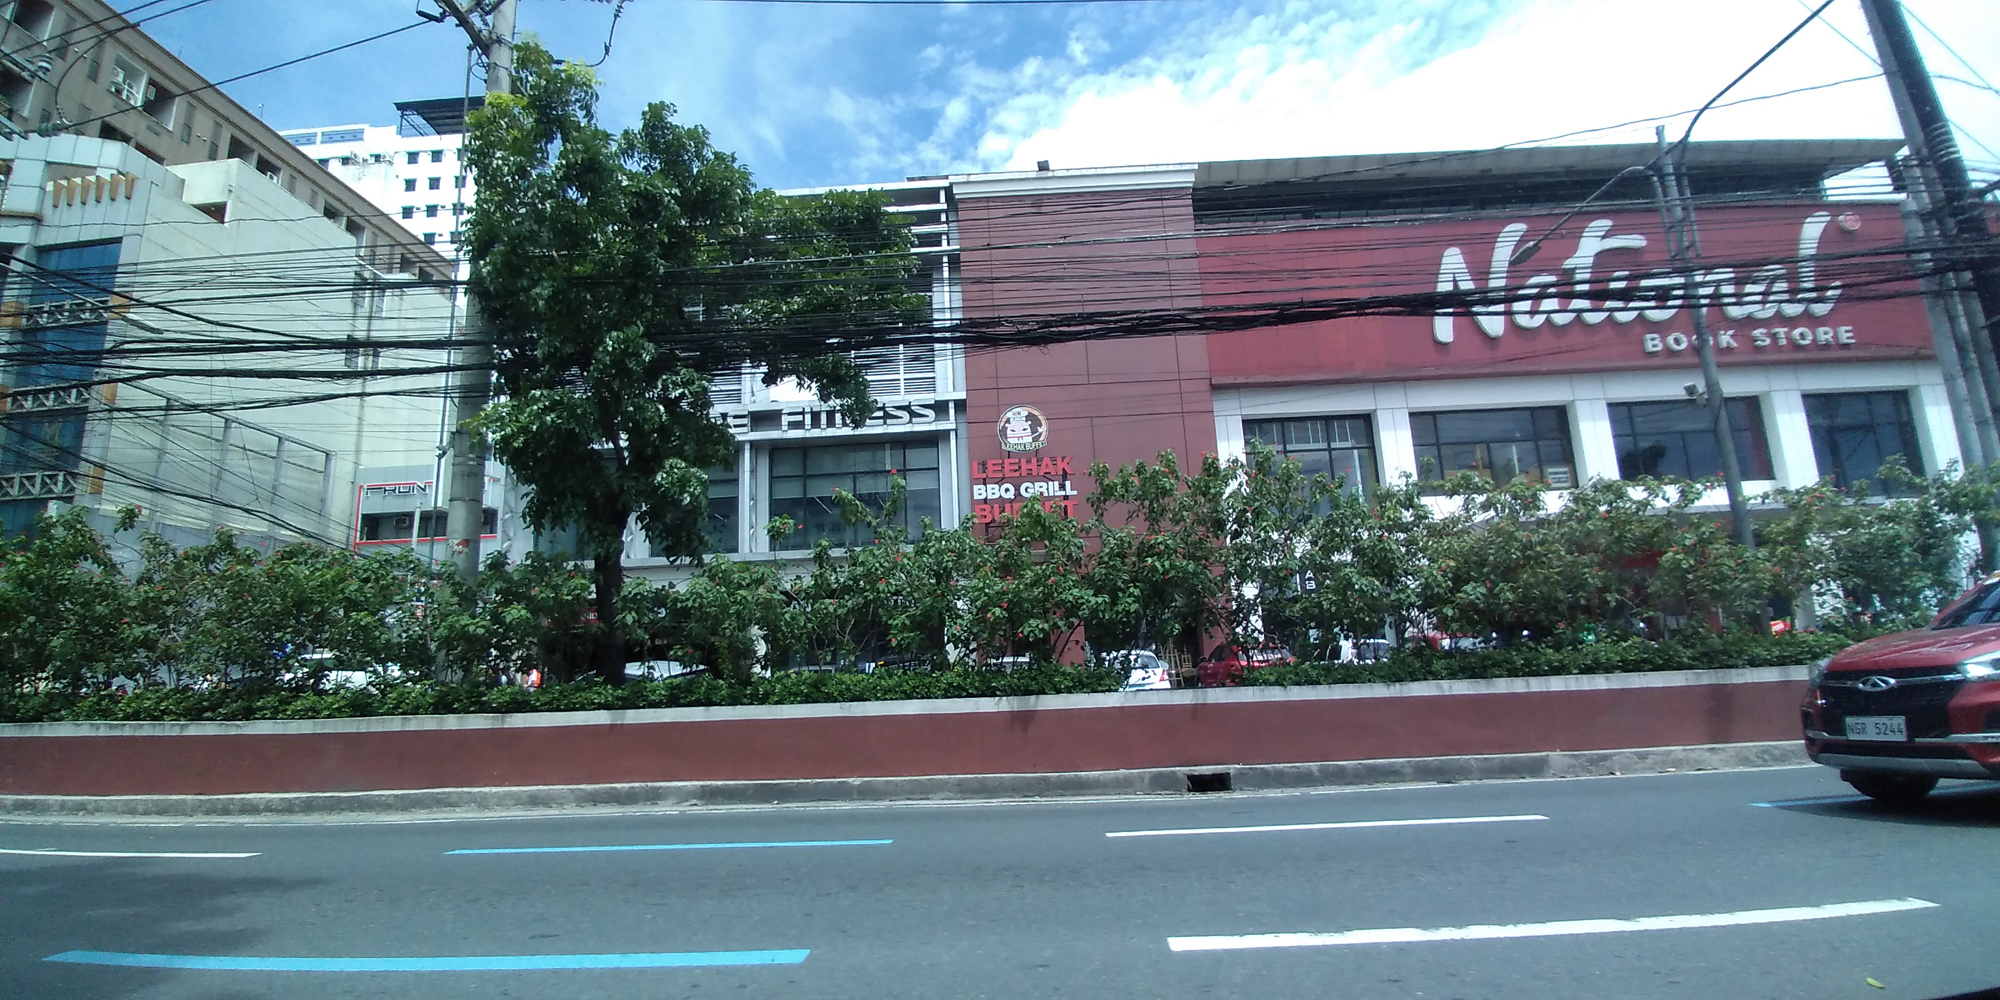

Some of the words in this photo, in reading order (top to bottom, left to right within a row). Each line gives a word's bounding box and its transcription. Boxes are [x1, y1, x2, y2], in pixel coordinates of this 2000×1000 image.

[1432, 211, 1842, 345] National
[1751, 326, 1856, 348] STORE
[972, 456, 1075, 479] LEEHAK
[364, 481, 433, 497] FRON
[973, 483, 1016, 500] BBQ
[1020, 480, 1078, 499] GRILL
[974, 500, 1079, 524] BUFET
[1847, 722, 1868, 735] NGR
[1874, 722, 1904, 736] 5244
